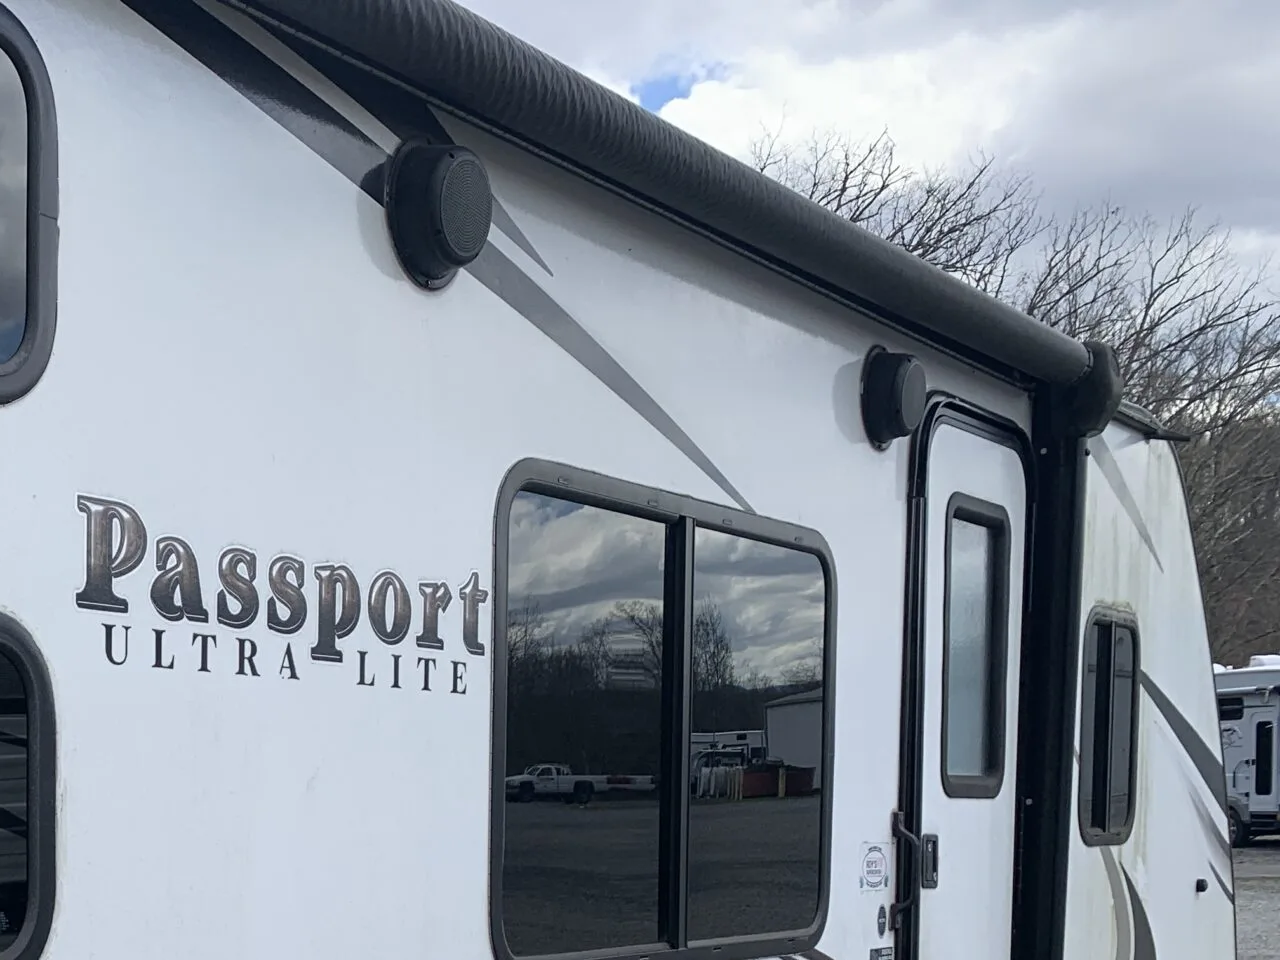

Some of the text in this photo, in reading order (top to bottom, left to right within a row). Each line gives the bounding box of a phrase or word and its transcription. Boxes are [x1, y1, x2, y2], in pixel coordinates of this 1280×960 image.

[75, 493, 489, 662] Passport
[101, 623, 468, 695] ULTRA LITE
